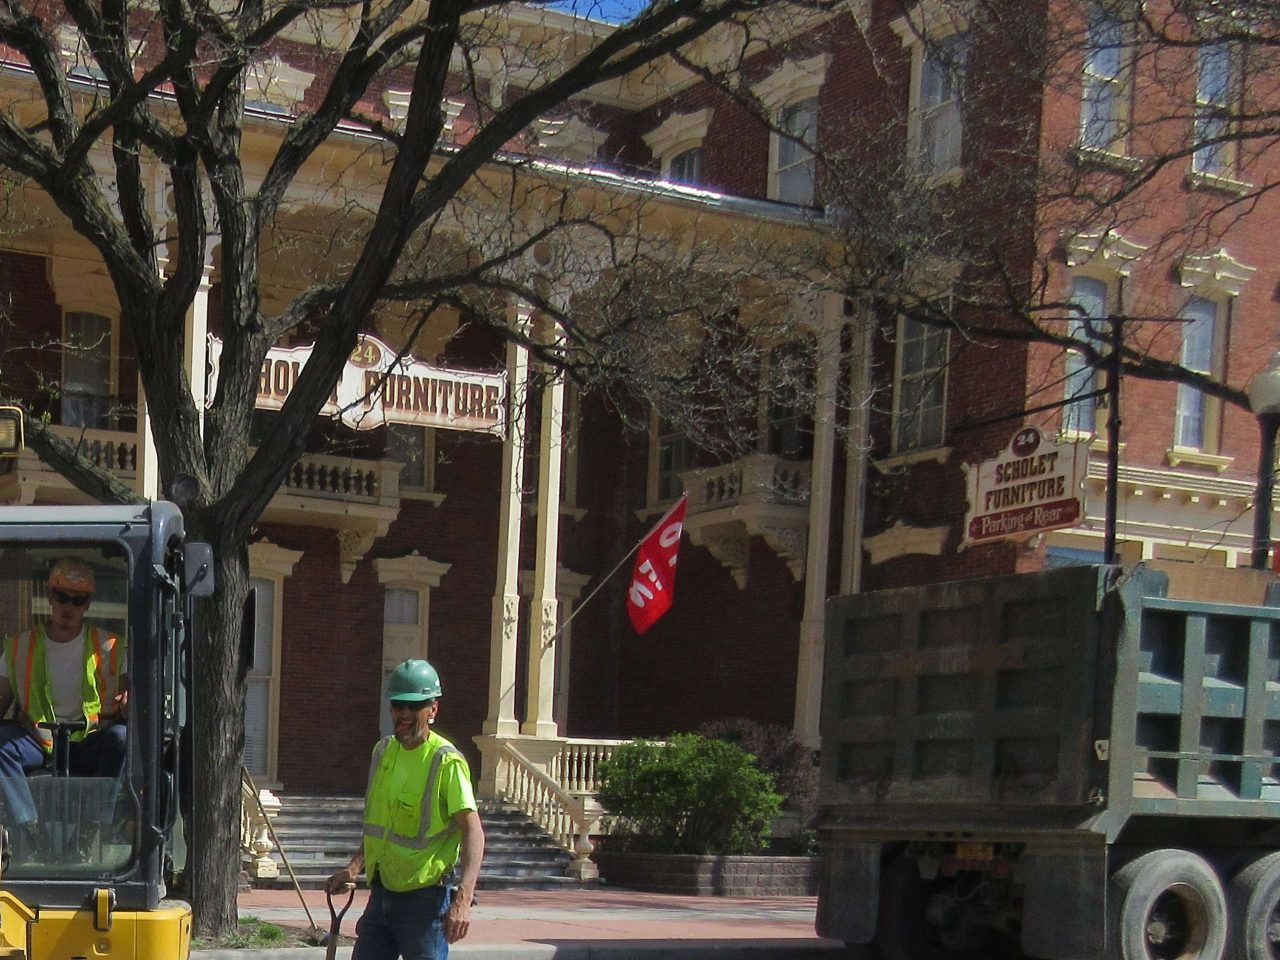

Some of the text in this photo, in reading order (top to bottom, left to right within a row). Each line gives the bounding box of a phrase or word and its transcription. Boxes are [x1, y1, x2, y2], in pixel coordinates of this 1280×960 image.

[351, 344, 376, 364] 24
[364, 370, 499, 419] FURNITURE
[1017, 433, 1035, 446] 24
[995, 451, 1058, 485] SCHOLET
[985, 476, 1065, 510] FURNITURE
[982, 513, 1024, 534] Parking
[1034, 507, 1062, 525] Rear
